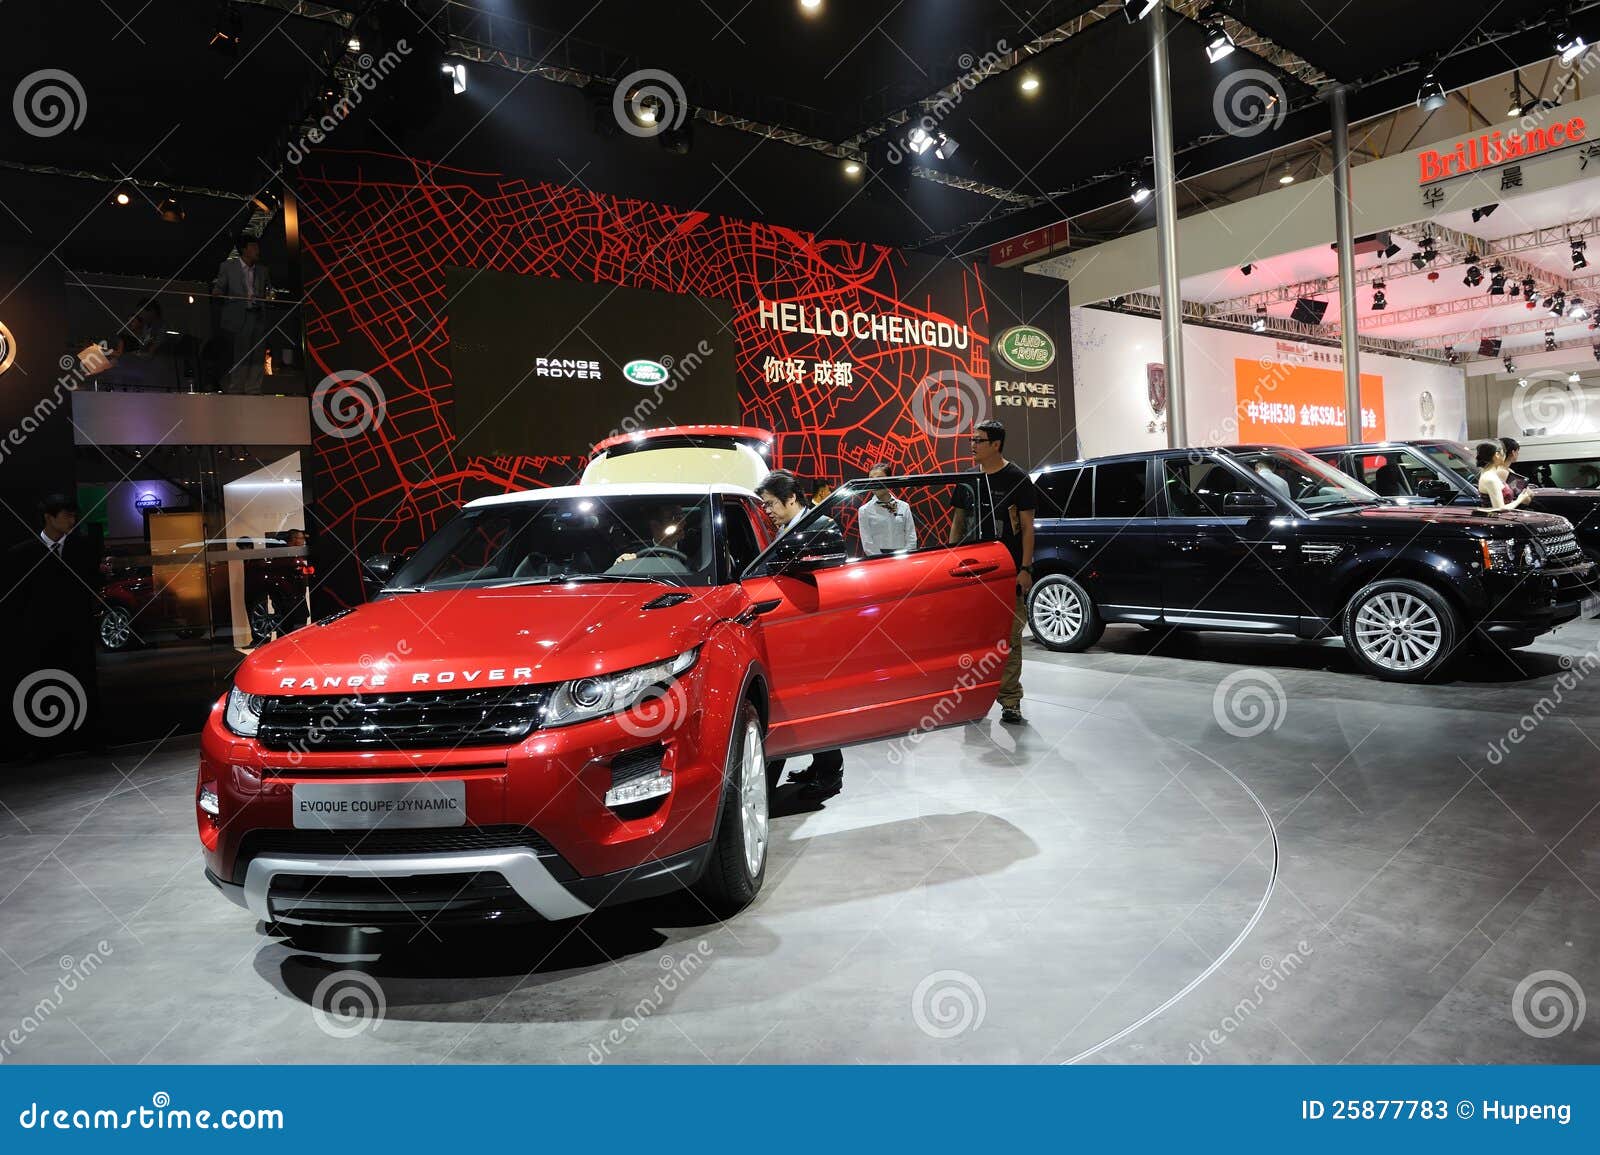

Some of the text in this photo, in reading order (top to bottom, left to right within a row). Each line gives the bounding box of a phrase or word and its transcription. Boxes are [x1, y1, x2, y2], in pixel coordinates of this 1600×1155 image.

[1418, 116, 1587, 184] Brilliance
[759, 300, 968, 350] HELLO CHENGDU
[1014, 333, 1041, 348] LAND
[1017, 347, 1049, 362] ROVER
[536, 357, 600, 370] RANGE
[763, 355, 853, 387] 你好 成都
[536, 368, 602, 380] ROVER
[994, 380, 1056, 395] RANGE
[995, 395, 1056, 409] ROVER
[279, 666, 533, 690] RANGE ROVER
[300, 797, 458, 813] EVOQUE COUPE DYNAMIC
